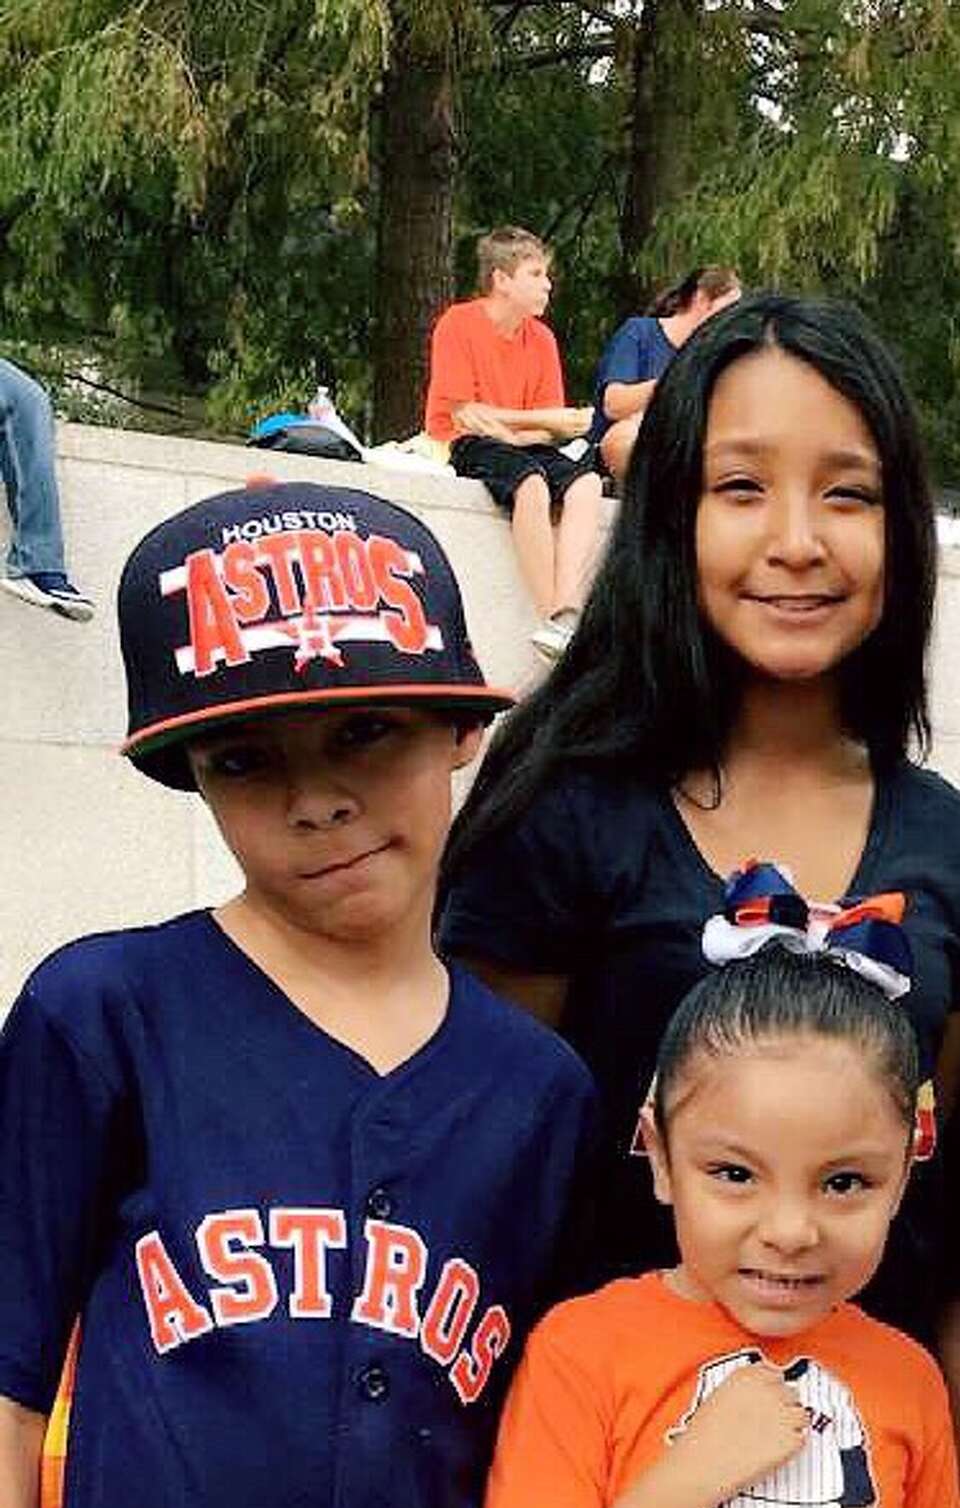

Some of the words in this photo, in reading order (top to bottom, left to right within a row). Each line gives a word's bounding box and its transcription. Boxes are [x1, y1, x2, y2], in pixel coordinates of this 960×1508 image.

[222, 511, 356, 543] HOUSTON
[186, 529, 427, 677] ASTROS
[135, 1207, 512, 1405] ASTROS
